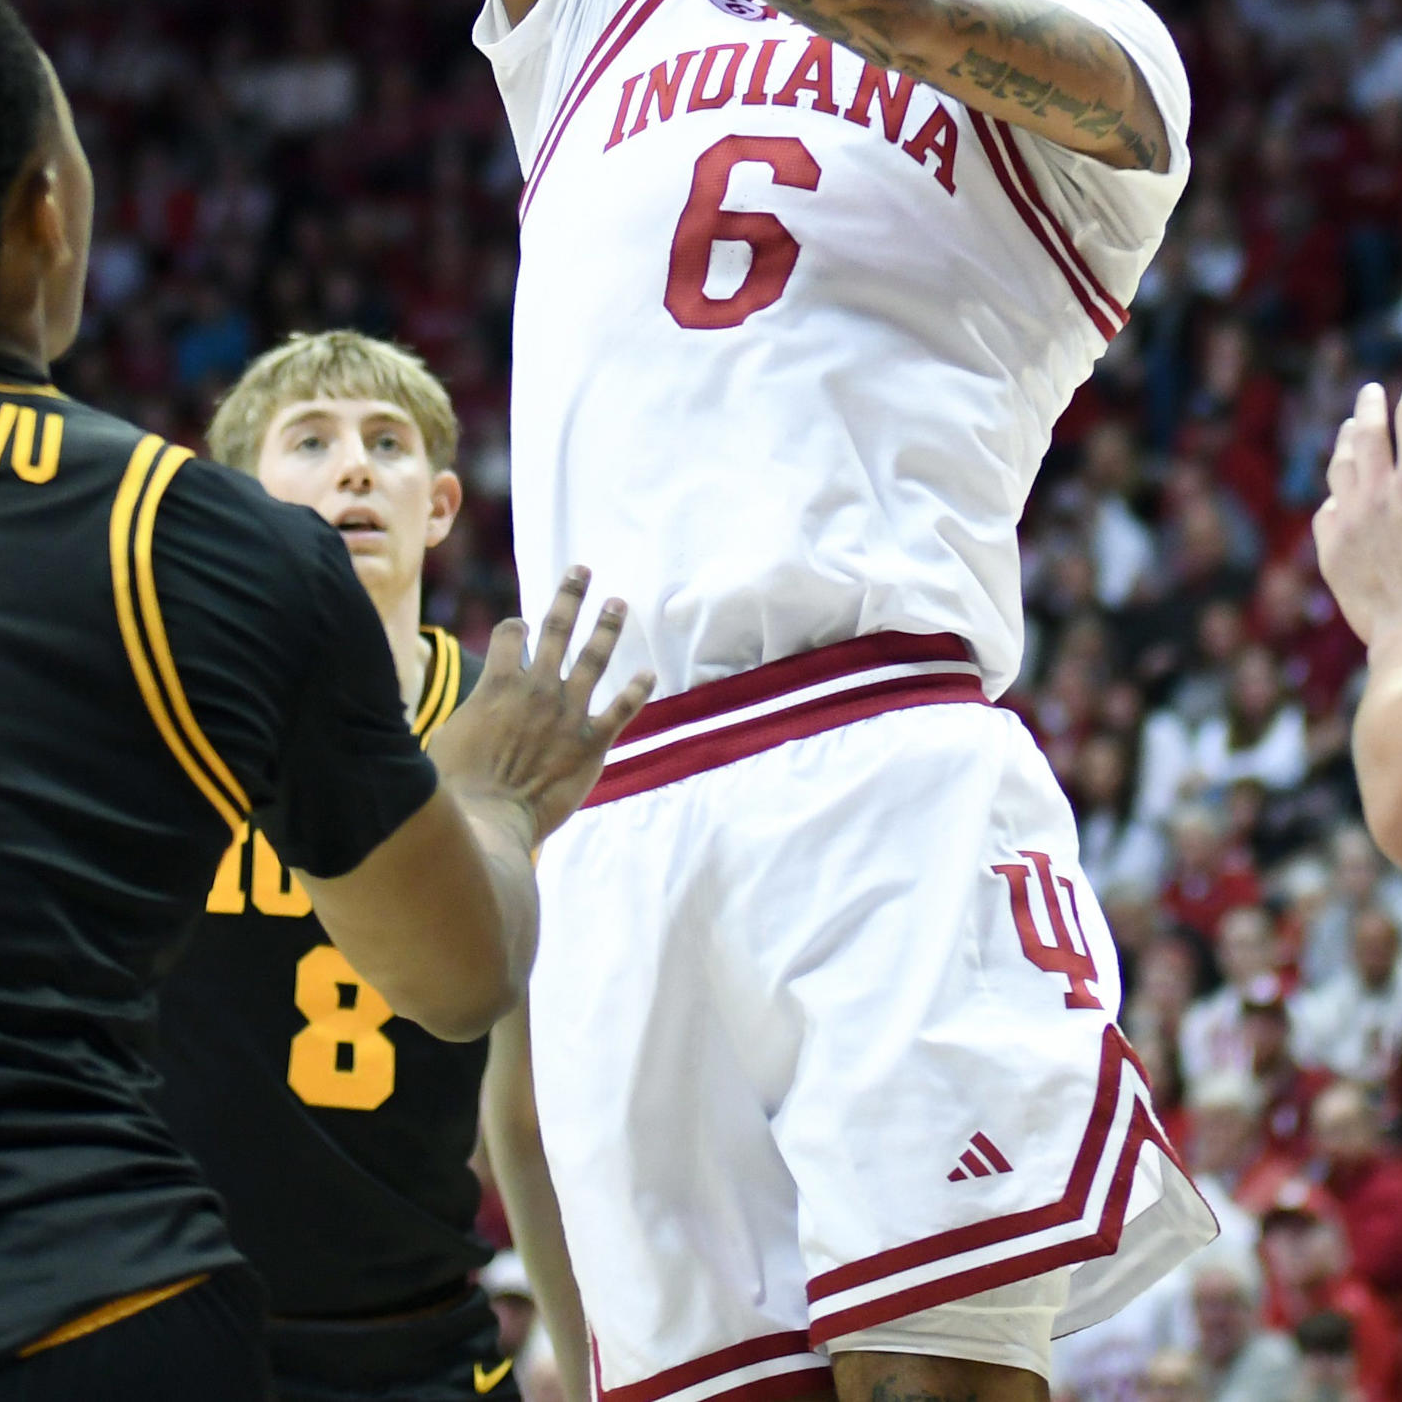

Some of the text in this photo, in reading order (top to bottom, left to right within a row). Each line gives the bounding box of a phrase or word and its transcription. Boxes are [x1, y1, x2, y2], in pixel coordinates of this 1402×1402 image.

[603, 36, 959, 197] INDIANA
[663, 134, 822, 329] 6
[287, 944, 395, 1111] 8
